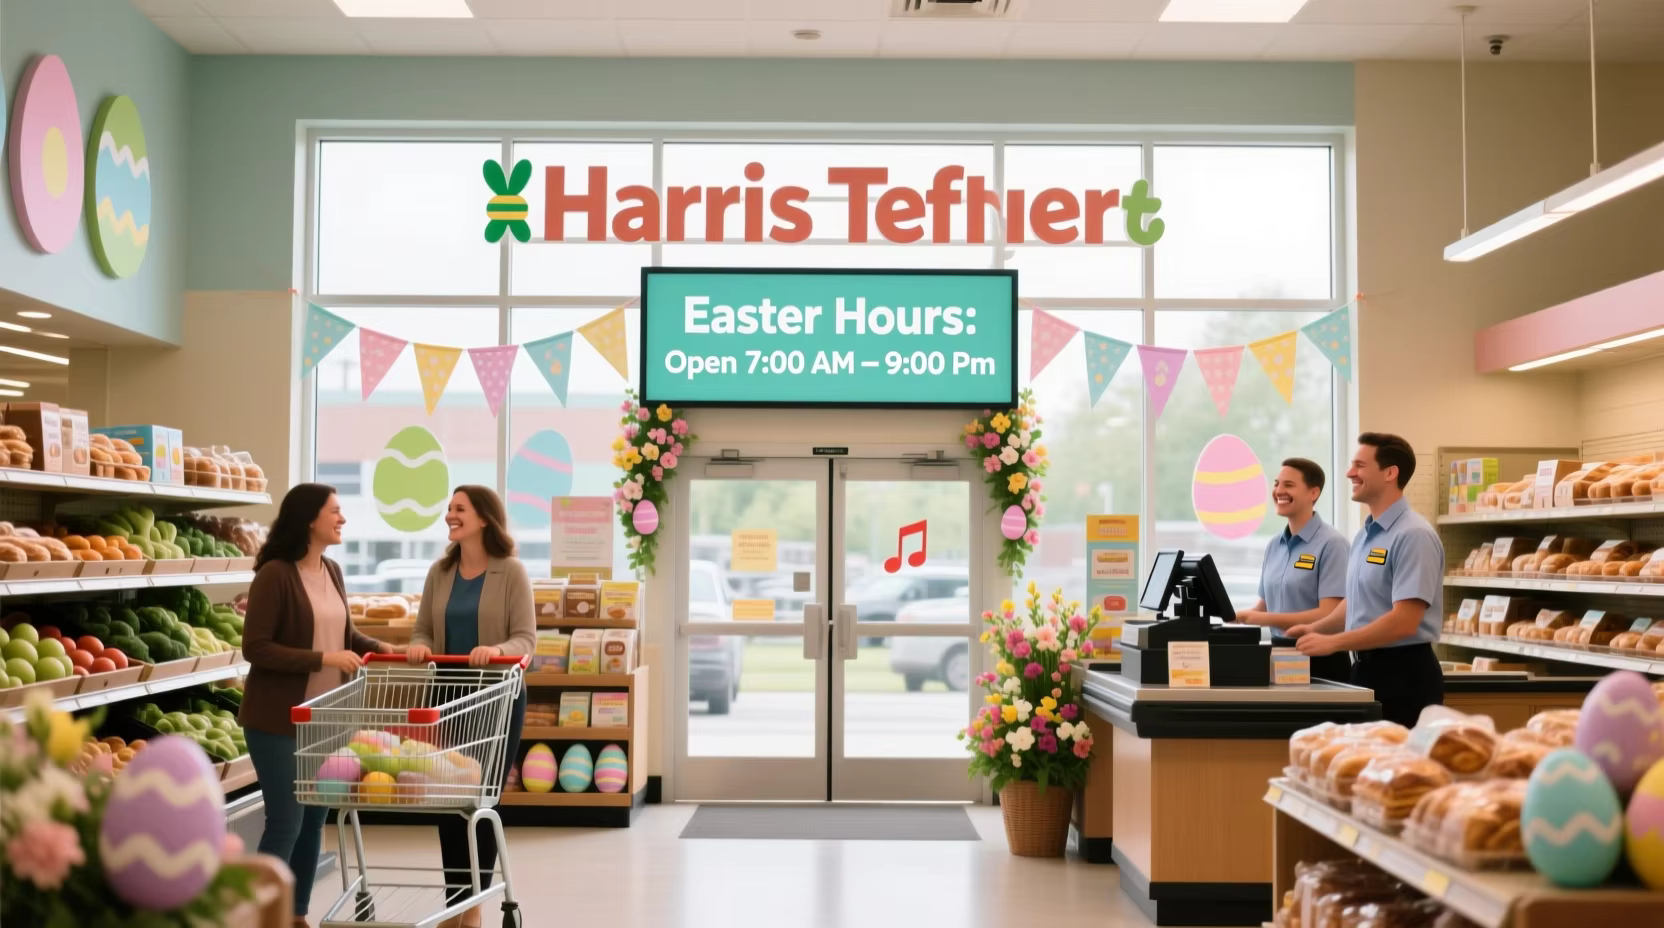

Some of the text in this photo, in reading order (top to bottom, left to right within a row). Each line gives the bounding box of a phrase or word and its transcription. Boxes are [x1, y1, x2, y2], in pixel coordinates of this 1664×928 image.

[543, 161, 813, 244] Harris
[684, 295, 977, 336] Easter Hours:
[664, 349, 738, 381] Open
[745, 349, 805, 375] 7:00
[810, 350, 855, 375] AM
[884, 350, 946, 376] 9:00
[952, 351, 996, 376] Pm
